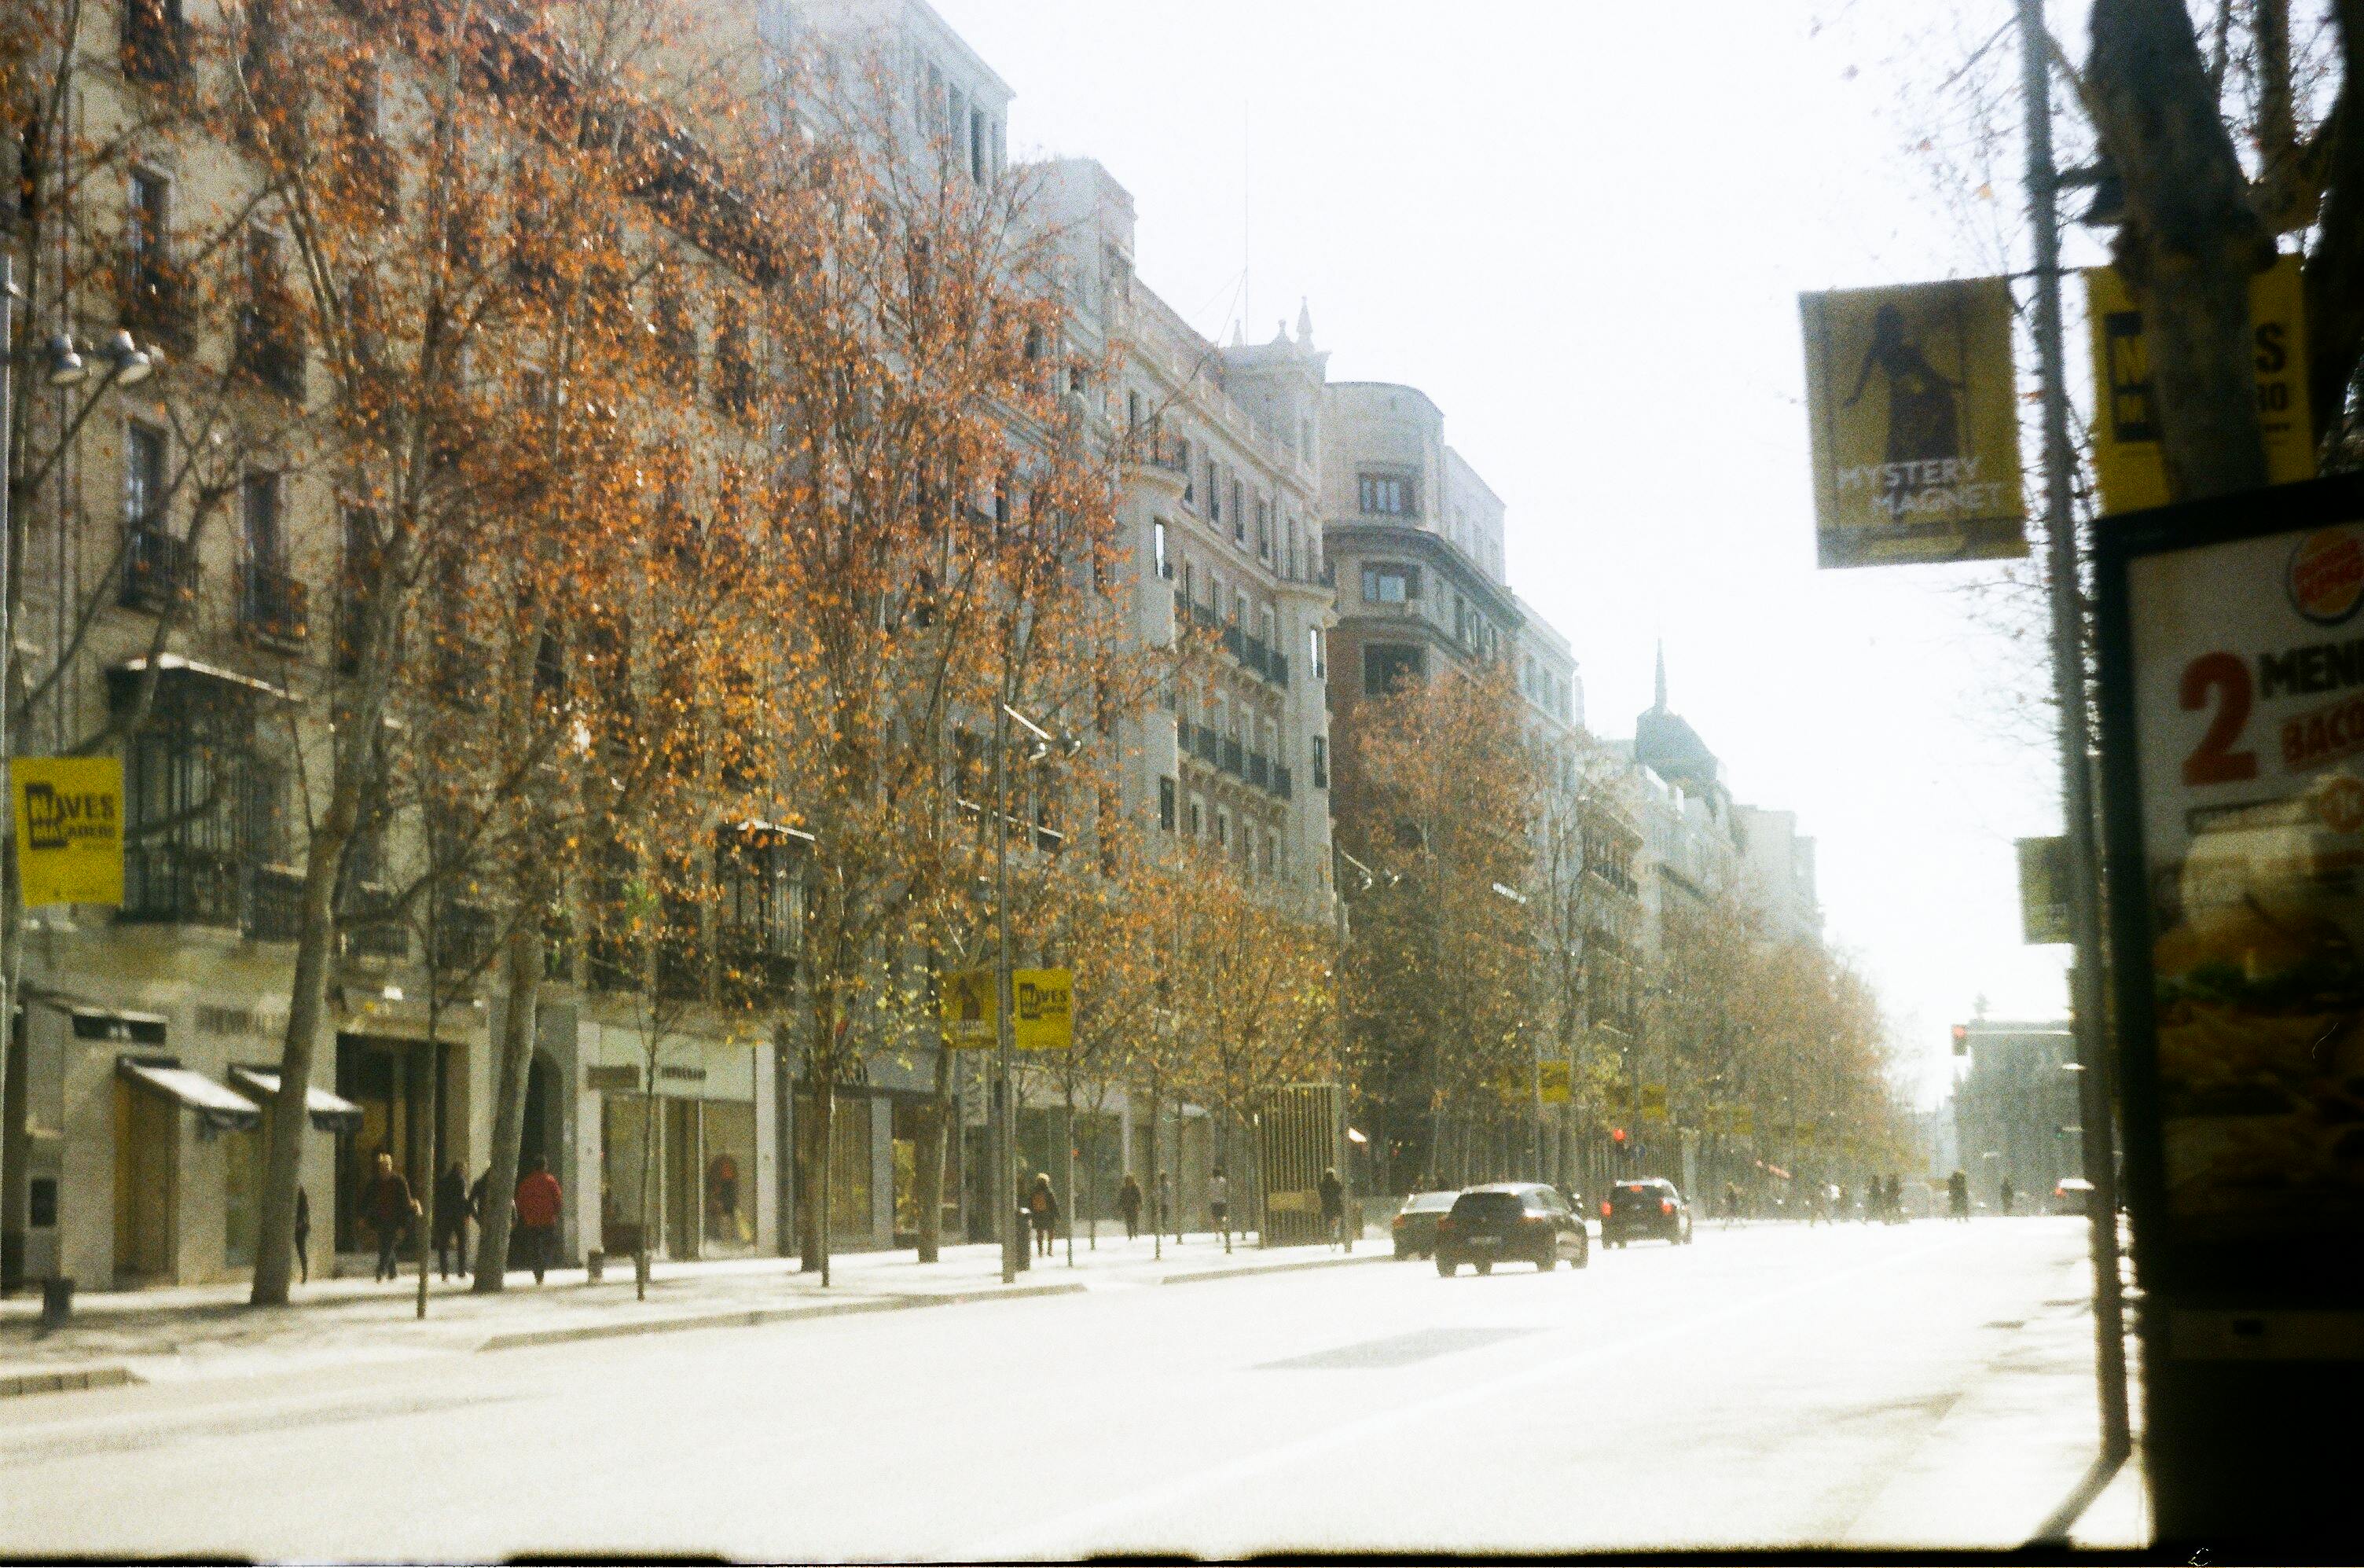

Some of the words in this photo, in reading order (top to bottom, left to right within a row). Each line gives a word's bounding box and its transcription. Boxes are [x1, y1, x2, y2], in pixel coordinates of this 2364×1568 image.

[1836, 455, 1982, 490] MYSTERY
[1871, 482, 2006, 516] MAGNET
[2179, 652, 2258, 786] 2
[2259, 639, 2364, 700] MEN
